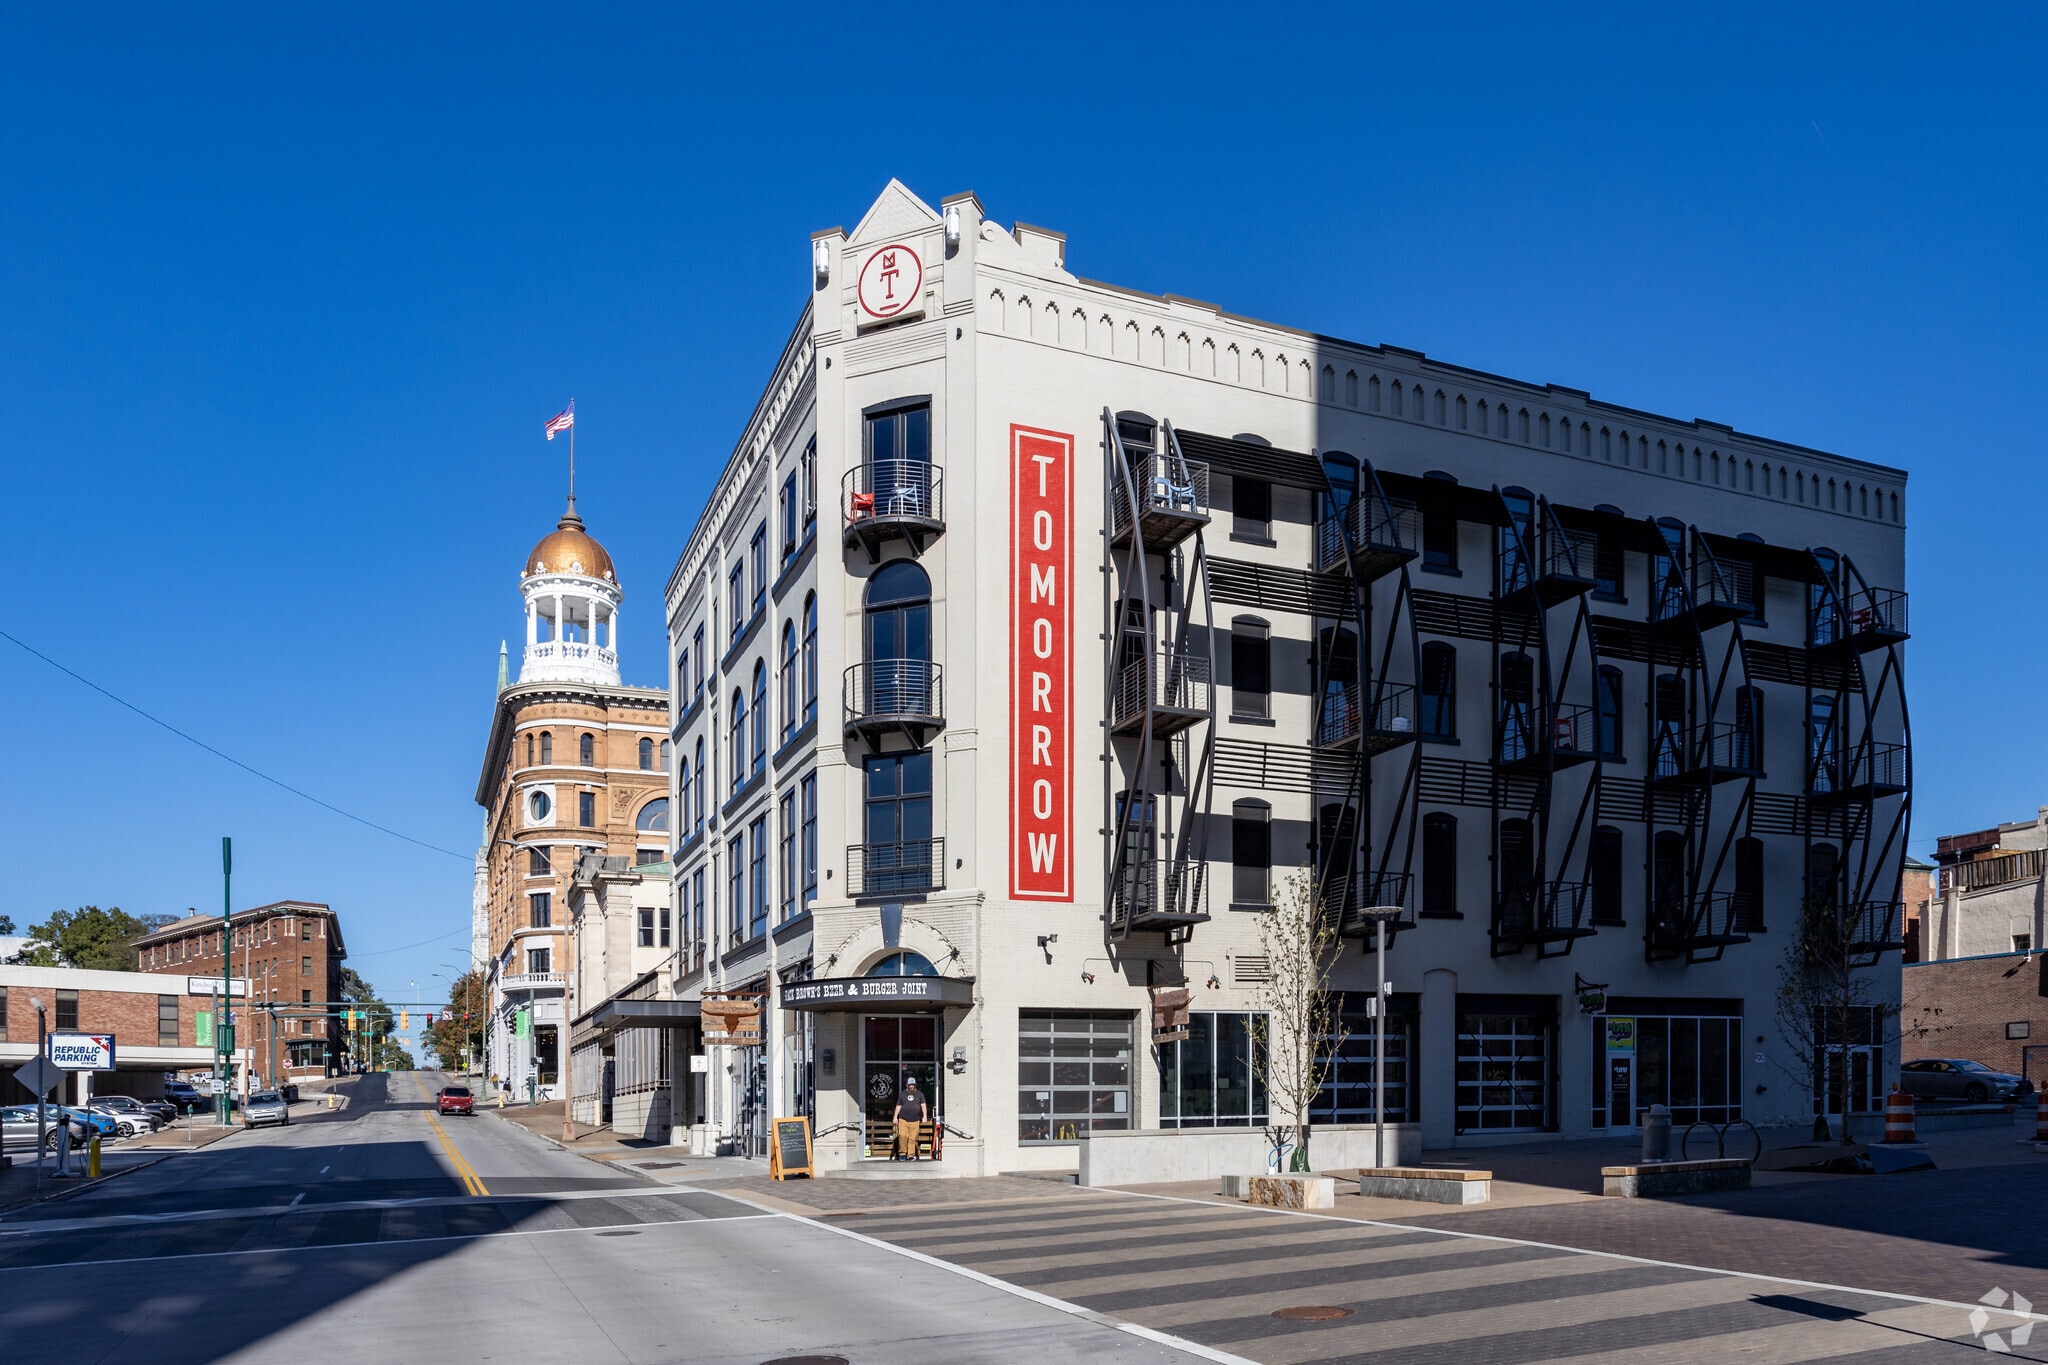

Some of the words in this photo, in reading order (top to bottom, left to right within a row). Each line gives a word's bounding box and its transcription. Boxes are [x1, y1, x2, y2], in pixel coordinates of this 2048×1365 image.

[1028, 454, 1058, 876] TOMORROW
[795, 985, 821, 1000] BROWN'S
[823, 983, 844, 998] BEER
[847, 983, 858, 996] &
[862, 982, 898, 995] BURGER
[902, 982, 928, 995] JOINT
[54, 1045, 101, 1054] REPUBLIC
[54, 1053, 98, 1062] PARKING
